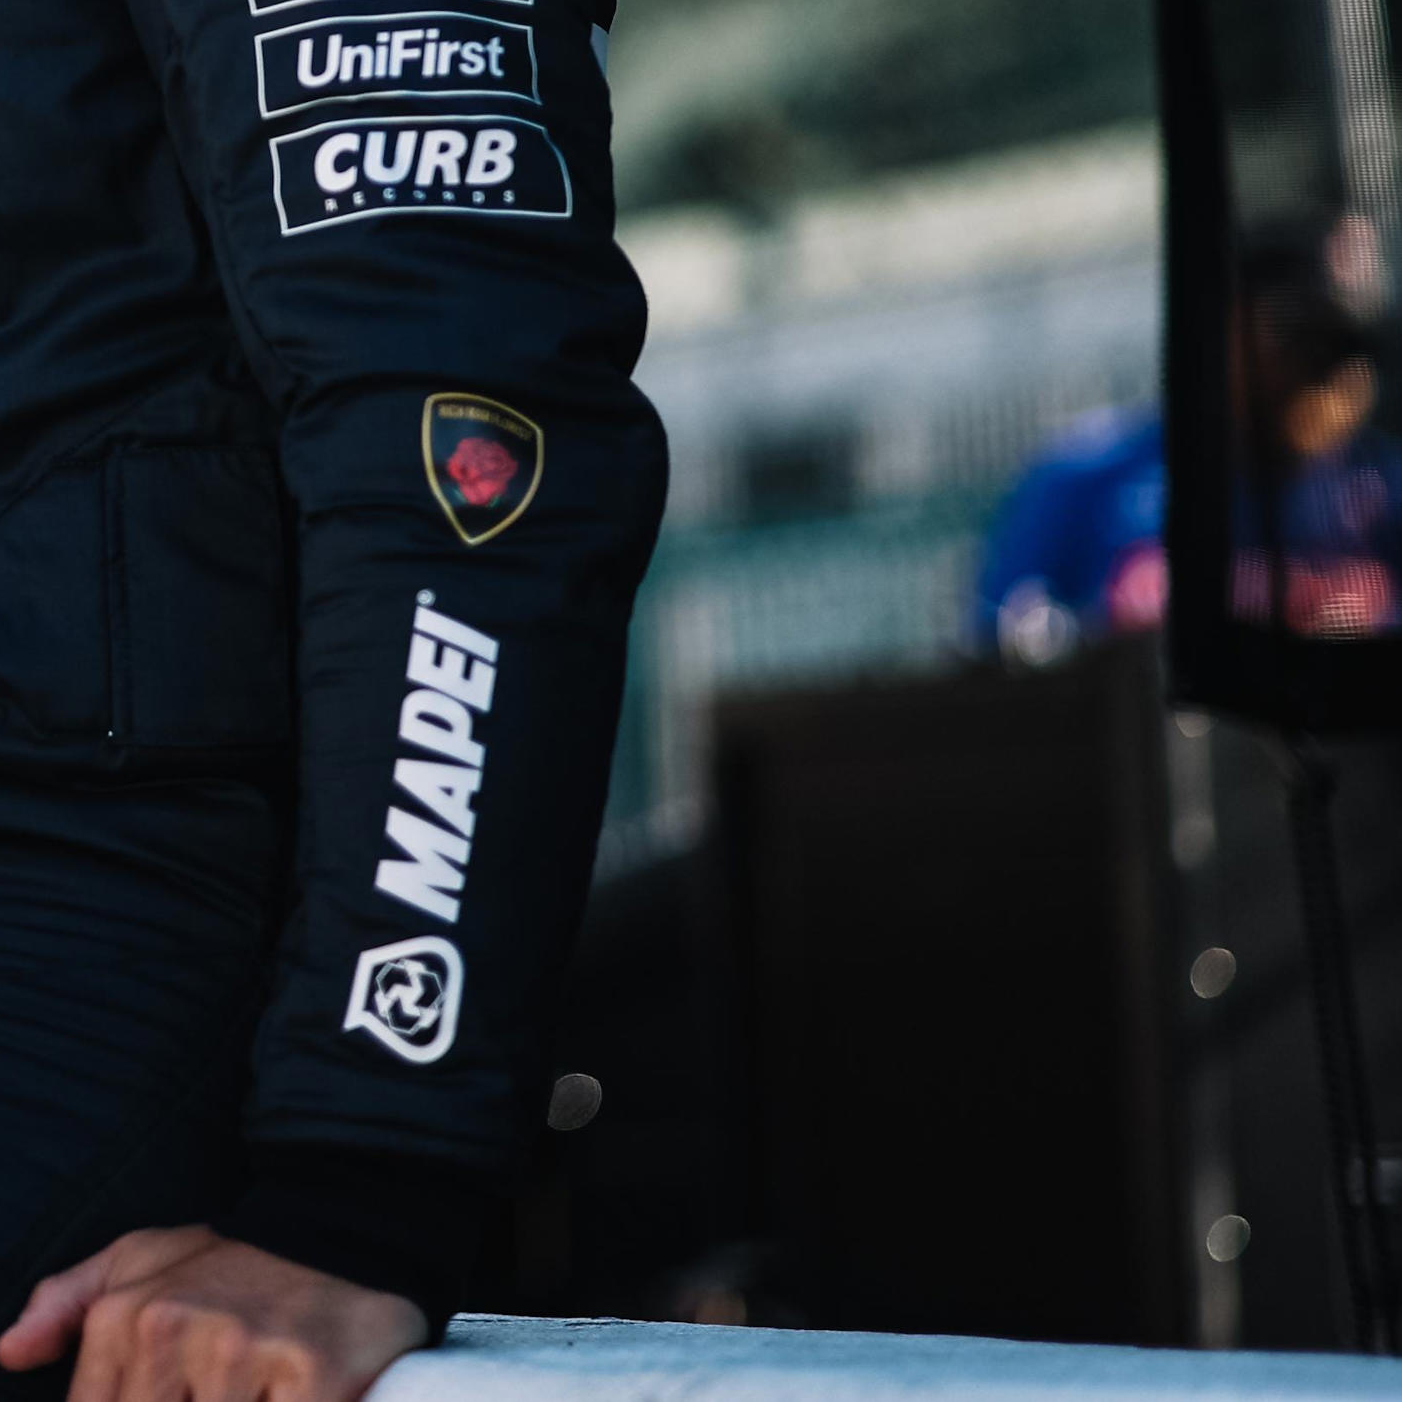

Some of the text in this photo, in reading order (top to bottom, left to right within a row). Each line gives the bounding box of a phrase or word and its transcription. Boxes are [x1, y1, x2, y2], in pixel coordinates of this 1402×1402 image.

[295, 27, 506, 88] UniFirst
[312, 128, 519, 195] CURB
[373, 603, 501, 926] MAPEI
